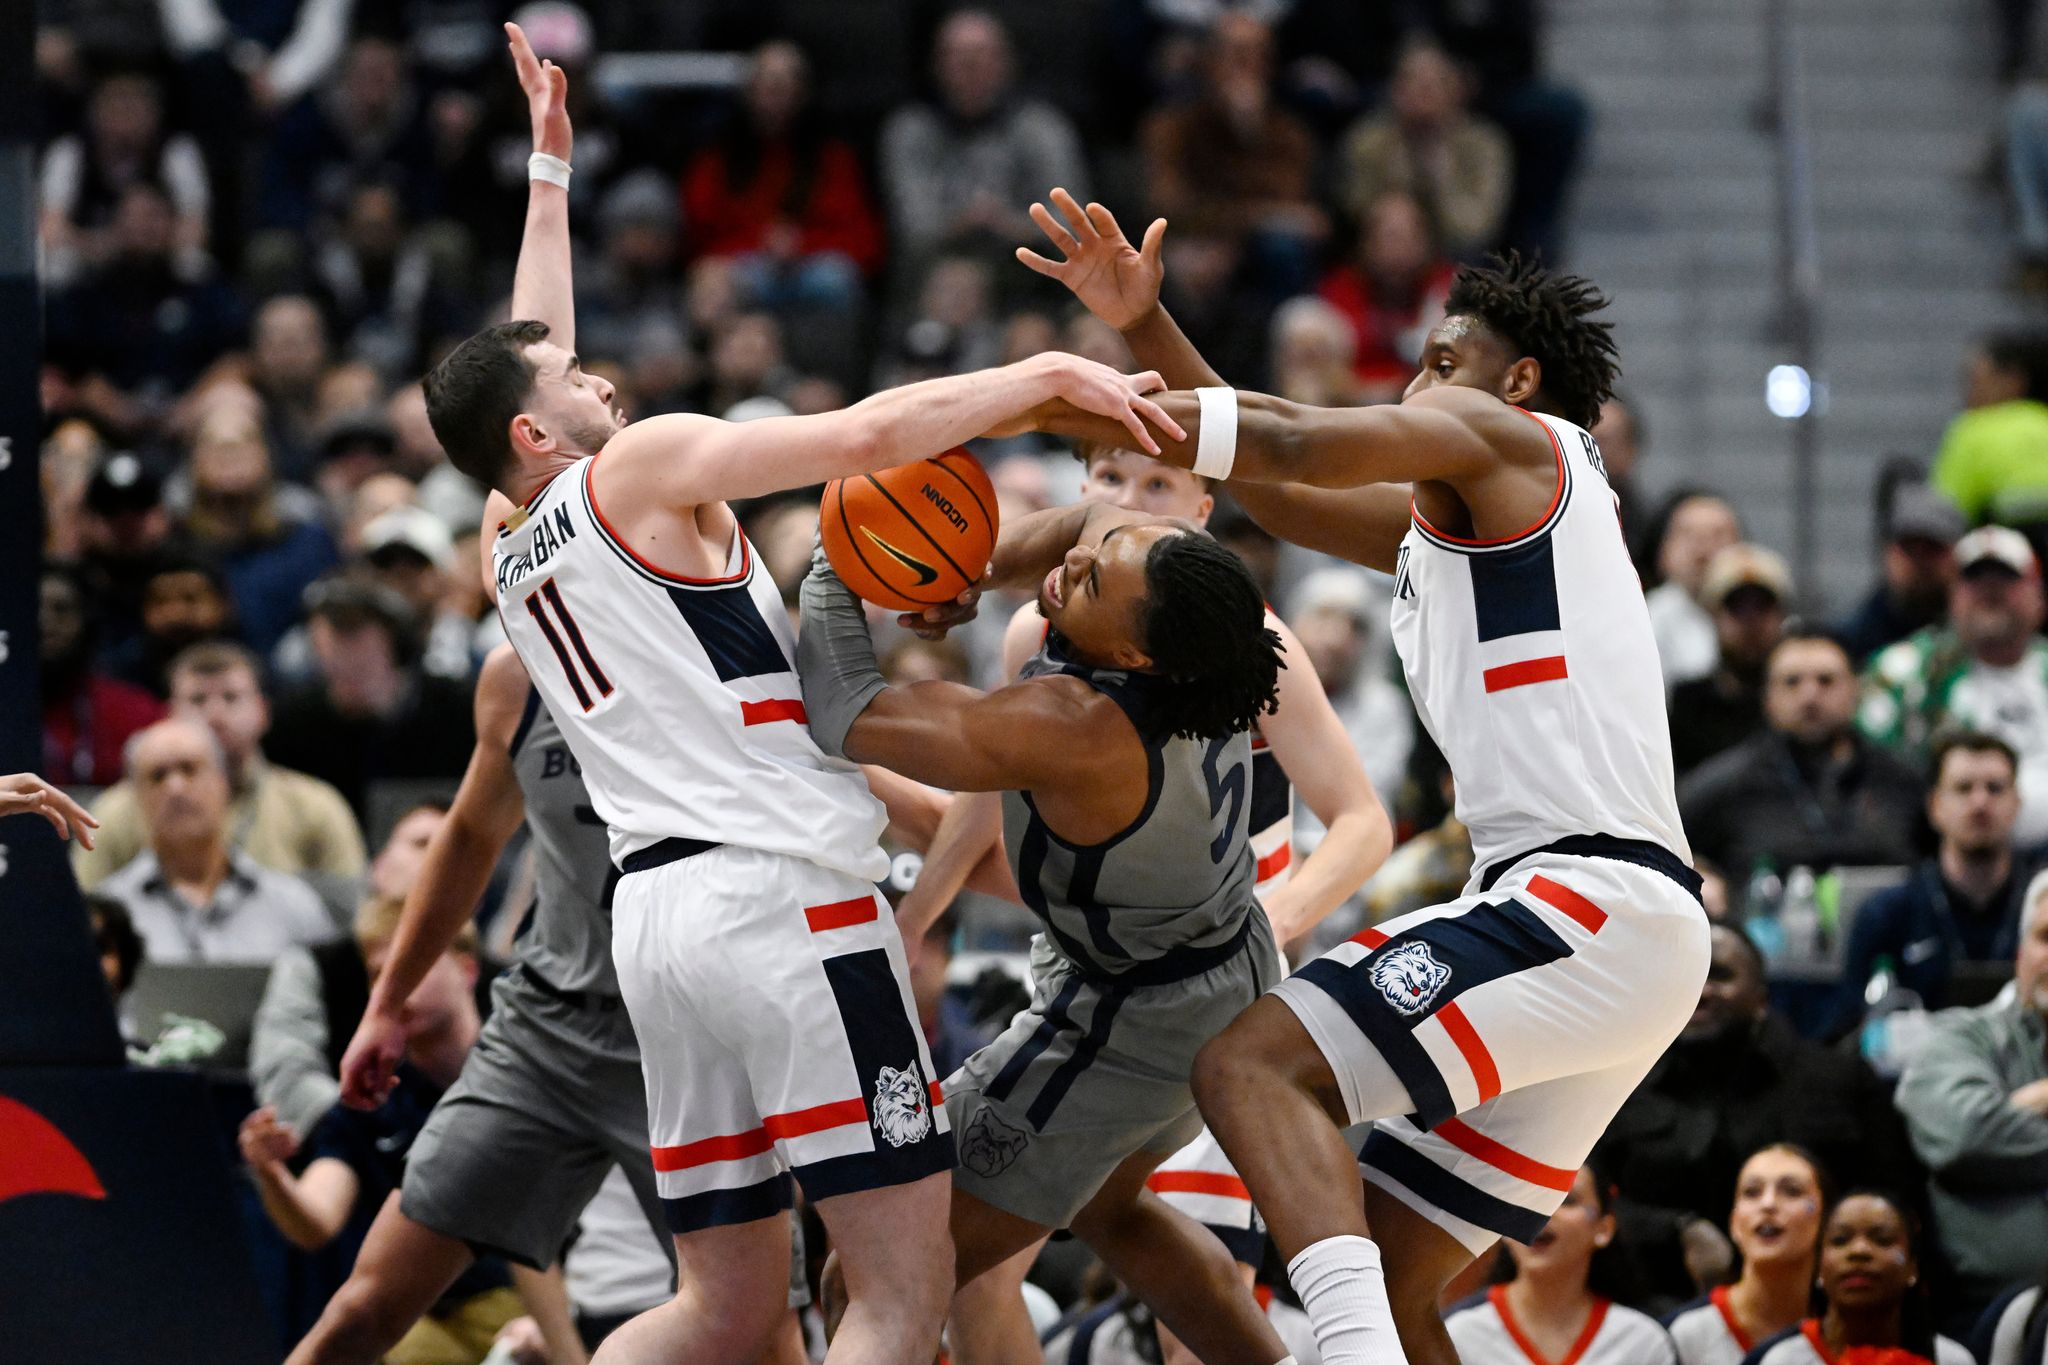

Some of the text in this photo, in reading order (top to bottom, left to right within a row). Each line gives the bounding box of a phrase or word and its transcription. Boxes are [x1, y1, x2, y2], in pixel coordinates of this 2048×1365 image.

[496, 501, 576, 593] ARABAN
[921, 483, 968, 534] UCONN
[525, 576, 614, 713] 11
[1202, 731, 1245, 865] 5
